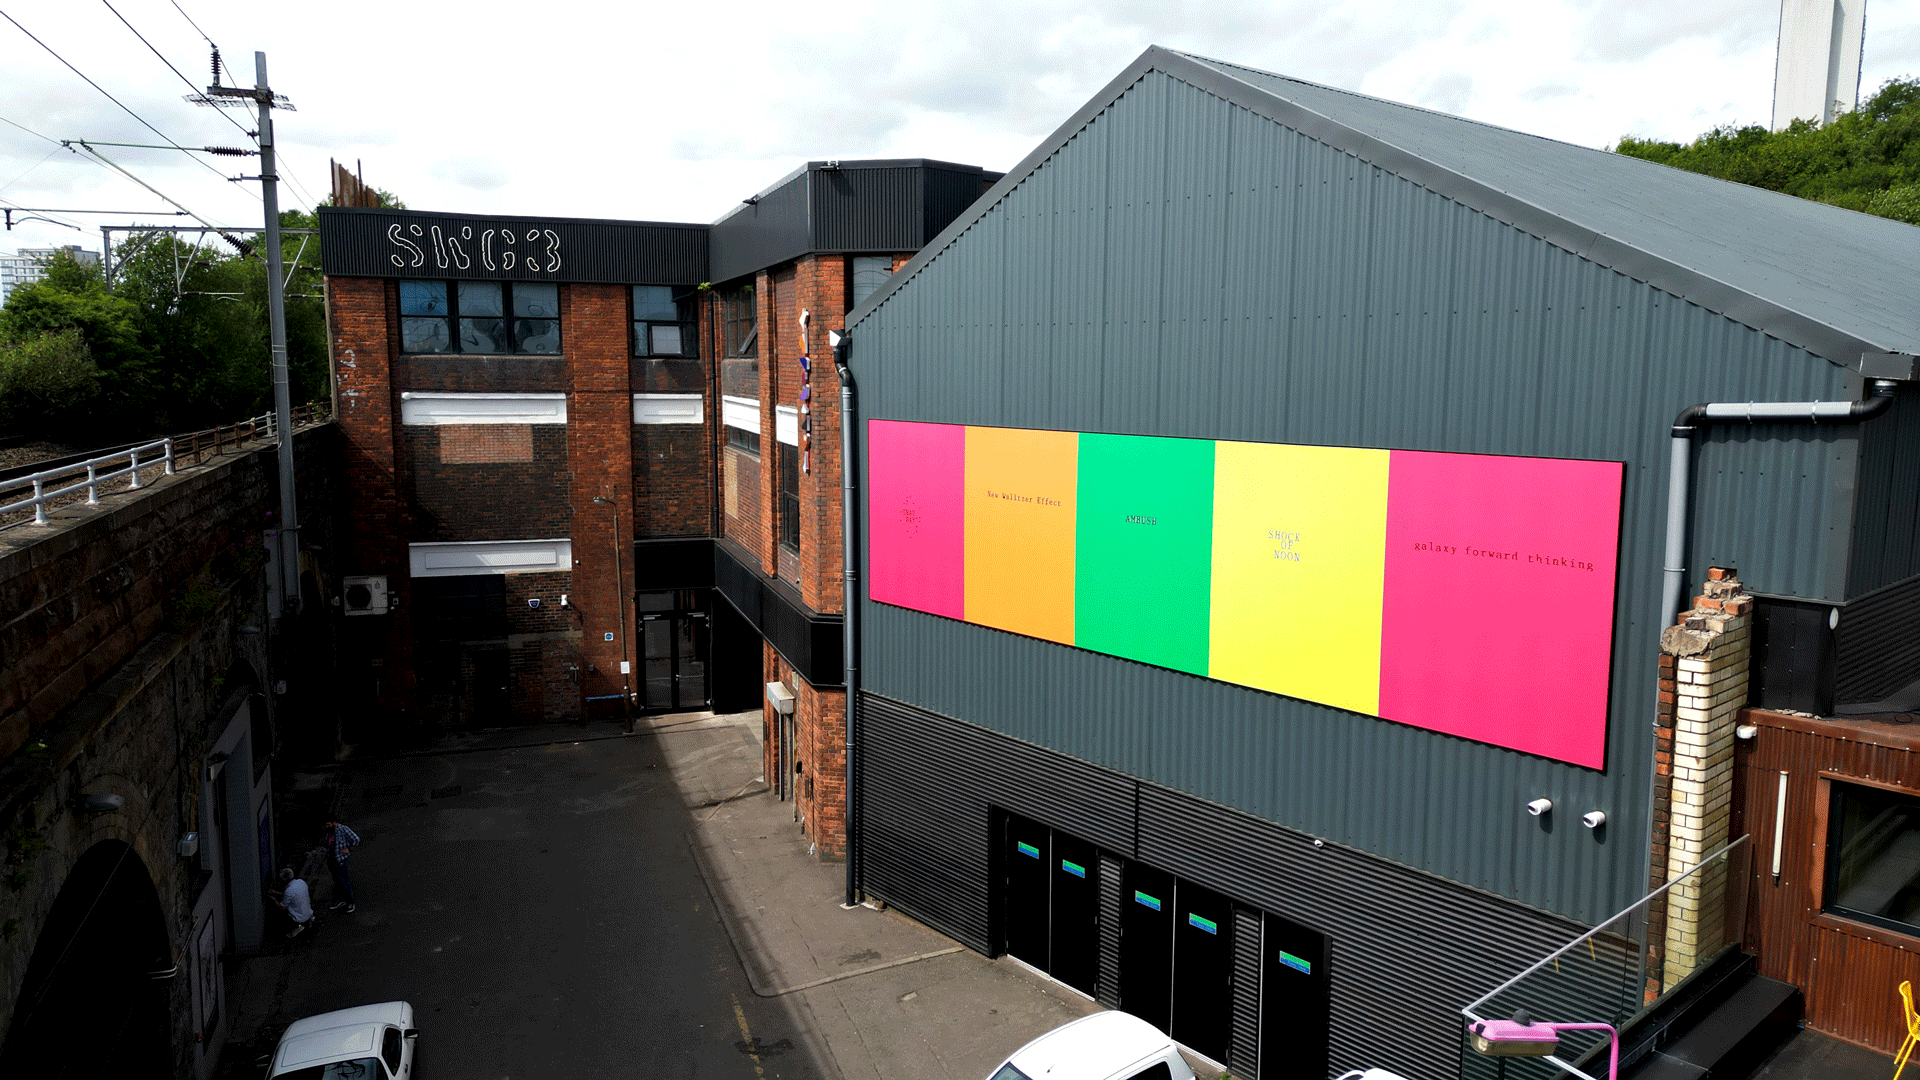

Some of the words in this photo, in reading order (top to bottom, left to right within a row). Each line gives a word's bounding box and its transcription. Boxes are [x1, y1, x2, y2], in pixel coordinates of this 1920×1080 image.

[388, 223, 561, 272] SWG3
[987, 490, 999, 499] New
[1036, 496, 1061, 507] Effect
[1125, 514, 1157, 526] AMBUSH
[1267, 529, 1300, 542] SHOCK
[1280, 540, 1294, 550] OF
[1273, 549, 1301, 562] NOON
[1414, 541, 1457, 555] galaxy
[1465, 545, 1518, 561] forward
[1528, 553, 1594, 572] thinking
